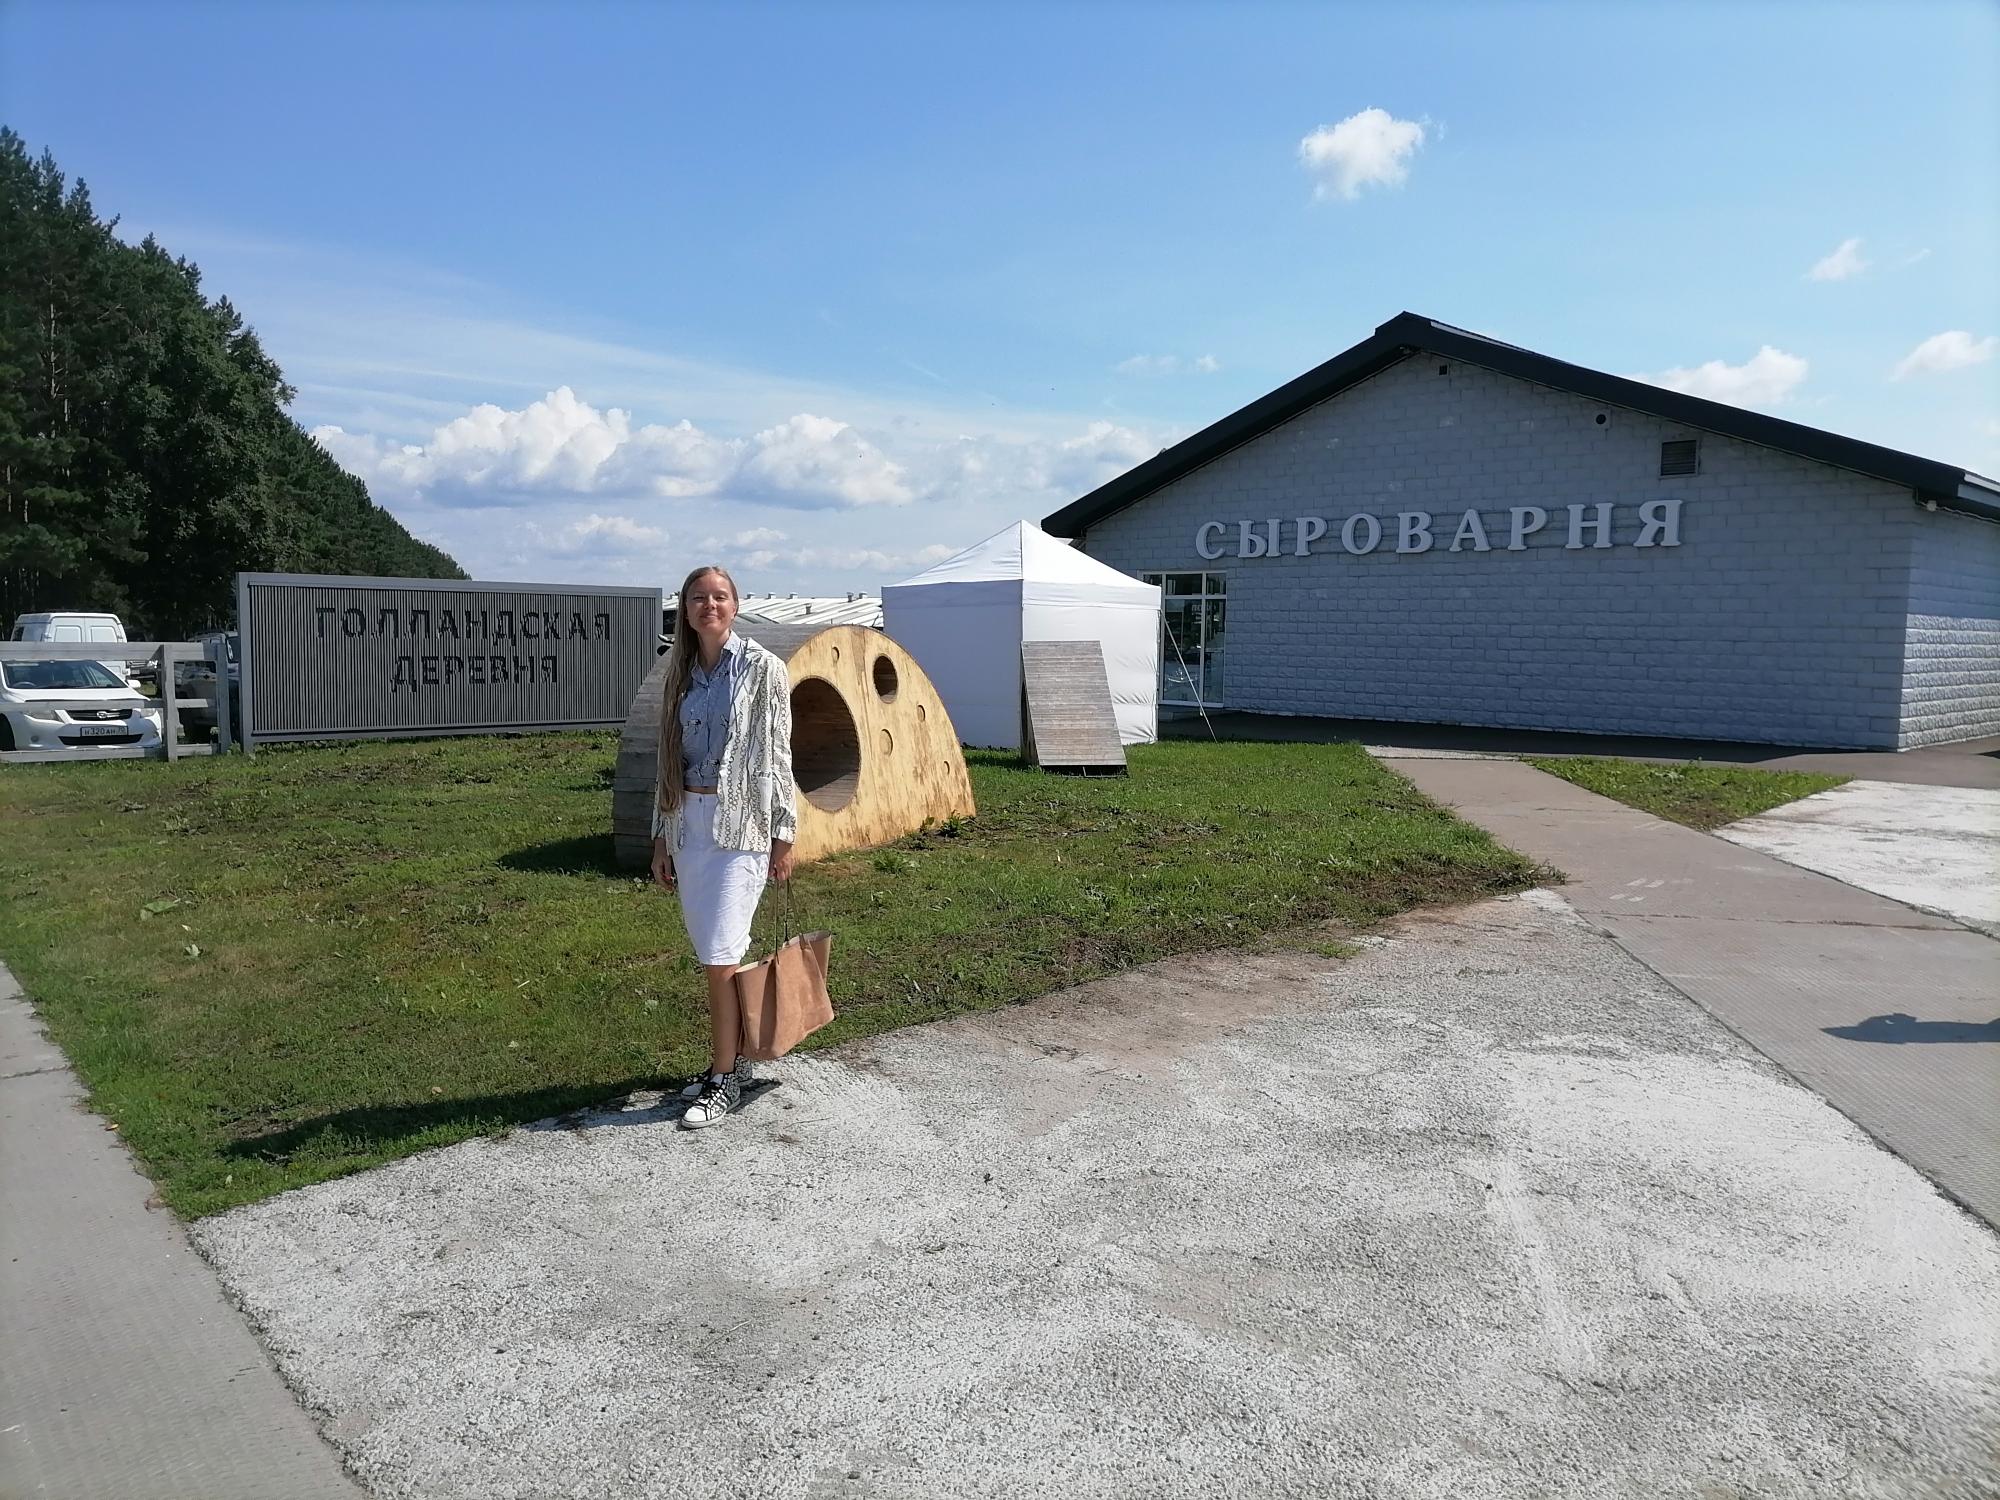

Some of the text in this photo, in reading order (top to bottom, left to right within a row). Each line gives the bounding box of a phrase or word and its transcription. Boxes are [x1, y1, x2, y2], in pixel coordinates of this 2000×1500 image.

[1195, 499, 1683, 560] СЫРОВАРНЯ
[316, 607, 610, 646] ГОЛЛАНДСКАЯ
[389, 655, 557, 692] ДЕРЕВНЯ
